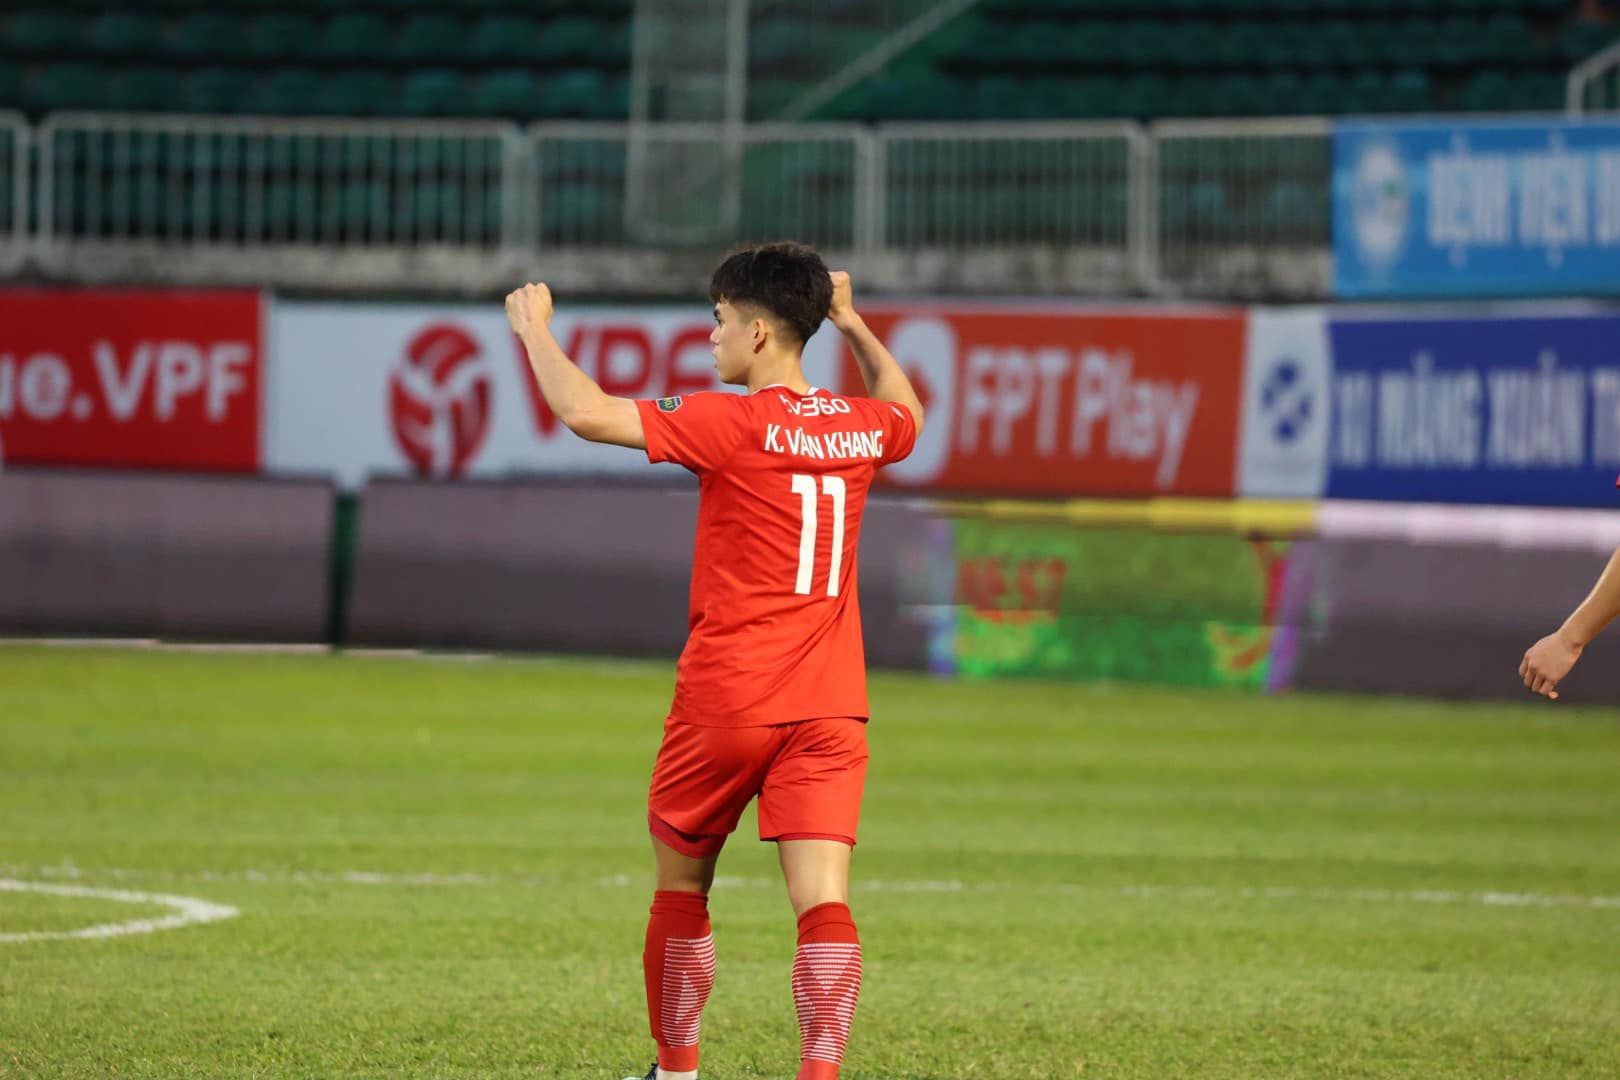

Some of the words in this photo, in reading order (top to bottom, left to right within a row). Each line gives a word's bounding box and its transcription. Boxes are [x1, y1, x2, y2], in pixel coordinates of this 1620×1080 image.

[764, 423, 784, 453] K.
[823, 429, 883, 459] KHANG
[960, 348, 1071, 456] FPT
[1070, 348, 1199, 488] Play
[791, 473, 846, 597] 11
